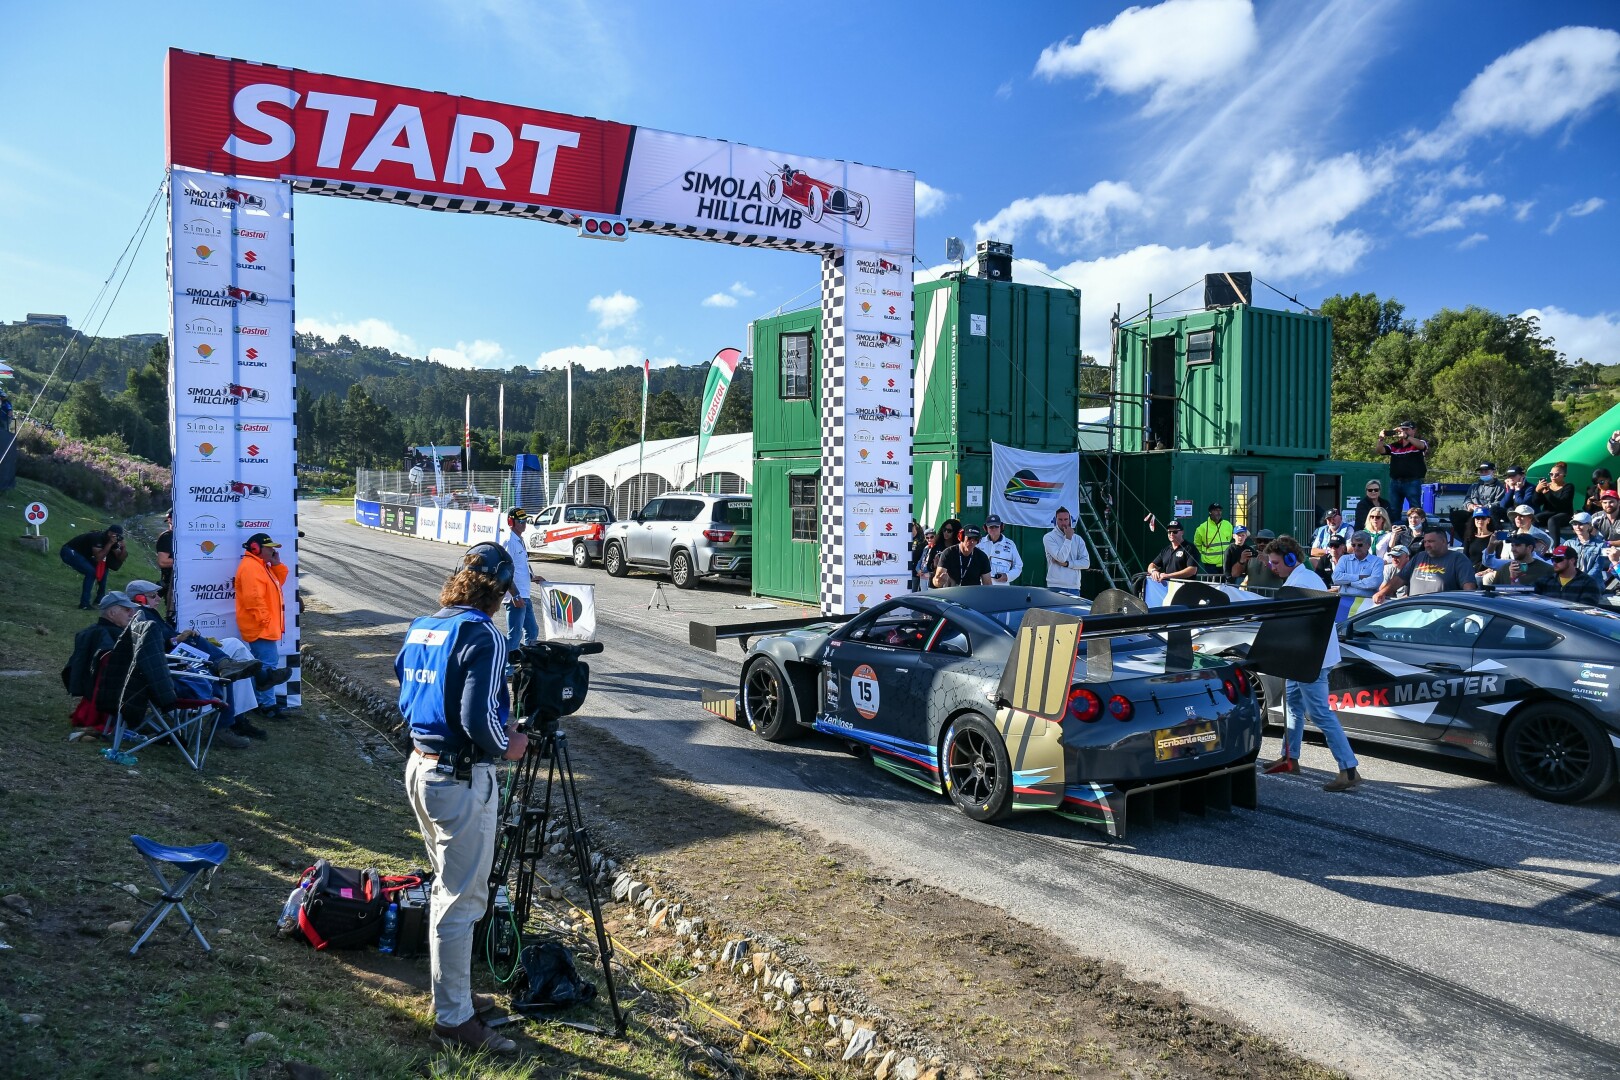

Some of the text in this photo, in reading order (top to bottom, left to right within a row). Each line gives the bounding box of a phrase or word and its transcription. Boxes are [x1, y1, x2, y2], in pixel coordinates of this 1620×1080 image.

[222, 83, 581, 196] START
[681, 171, 762, 202] SIMOLA
[184, 189, 217, 199] SIMOLA
[190, 198, 235, 209] HILLCLIMB
[696, 196, 803, 230] HILLCLIMB
[184, 224, 221, 234] Simola
[240, 230, 265, 238] Castrol
[186, 288, 219, 298] SIMOLA
[192, 297, 237, 307] HILLCLIMB
[186, 324, 222, 333] Simola
[242, 327, 267, 335] Castrol
[188, 388, 221, 396] SIMOLA
[194, 396, 238, 405] HILLCLIMB
[707, 384, 725, 423] Castrol
[477, 524, 494, 534] SUZUKI
[196, 592, 235, 600] HILLCLIM
[404, 667, 437, 684] TV CEW
[858, 681, 872, 702] 15
[1328, 674, 1498, 711] RACK MASTER
[1157, 734, 1217, 749] Scribante Racing
[1473, 740, 1493, 748] DRIVE
